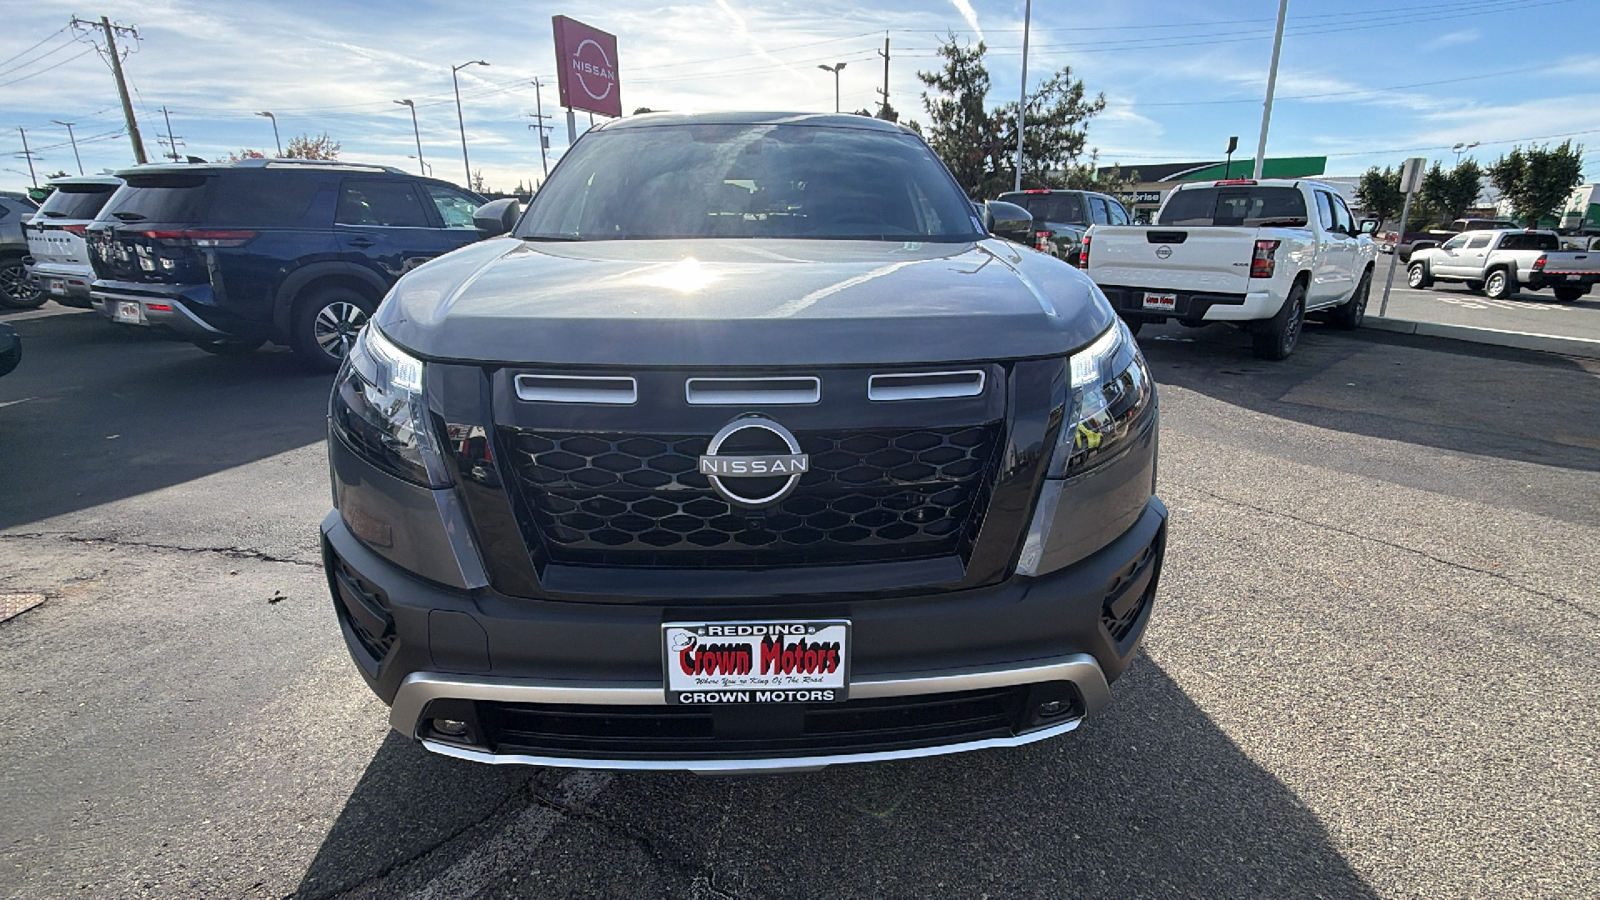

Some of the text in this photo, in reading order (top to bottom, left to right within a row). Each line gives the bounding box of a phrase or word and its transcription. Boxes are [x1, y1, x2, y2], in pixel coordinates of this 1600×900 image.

[573, 59, 614, 80] NISSAN
[702, 458, 806, 473] NISSAN
[708, 625, 805, 636] REDDING
[679, 640, 839, 676] Crown Motors
[695, 677, 719, 685] Where
[749, 677, 769, 685] King
[772, 676, 783, 685] Of
[785, 676, 799, 684] The
[680, 690, 834, 703] CROWN MOTORS
